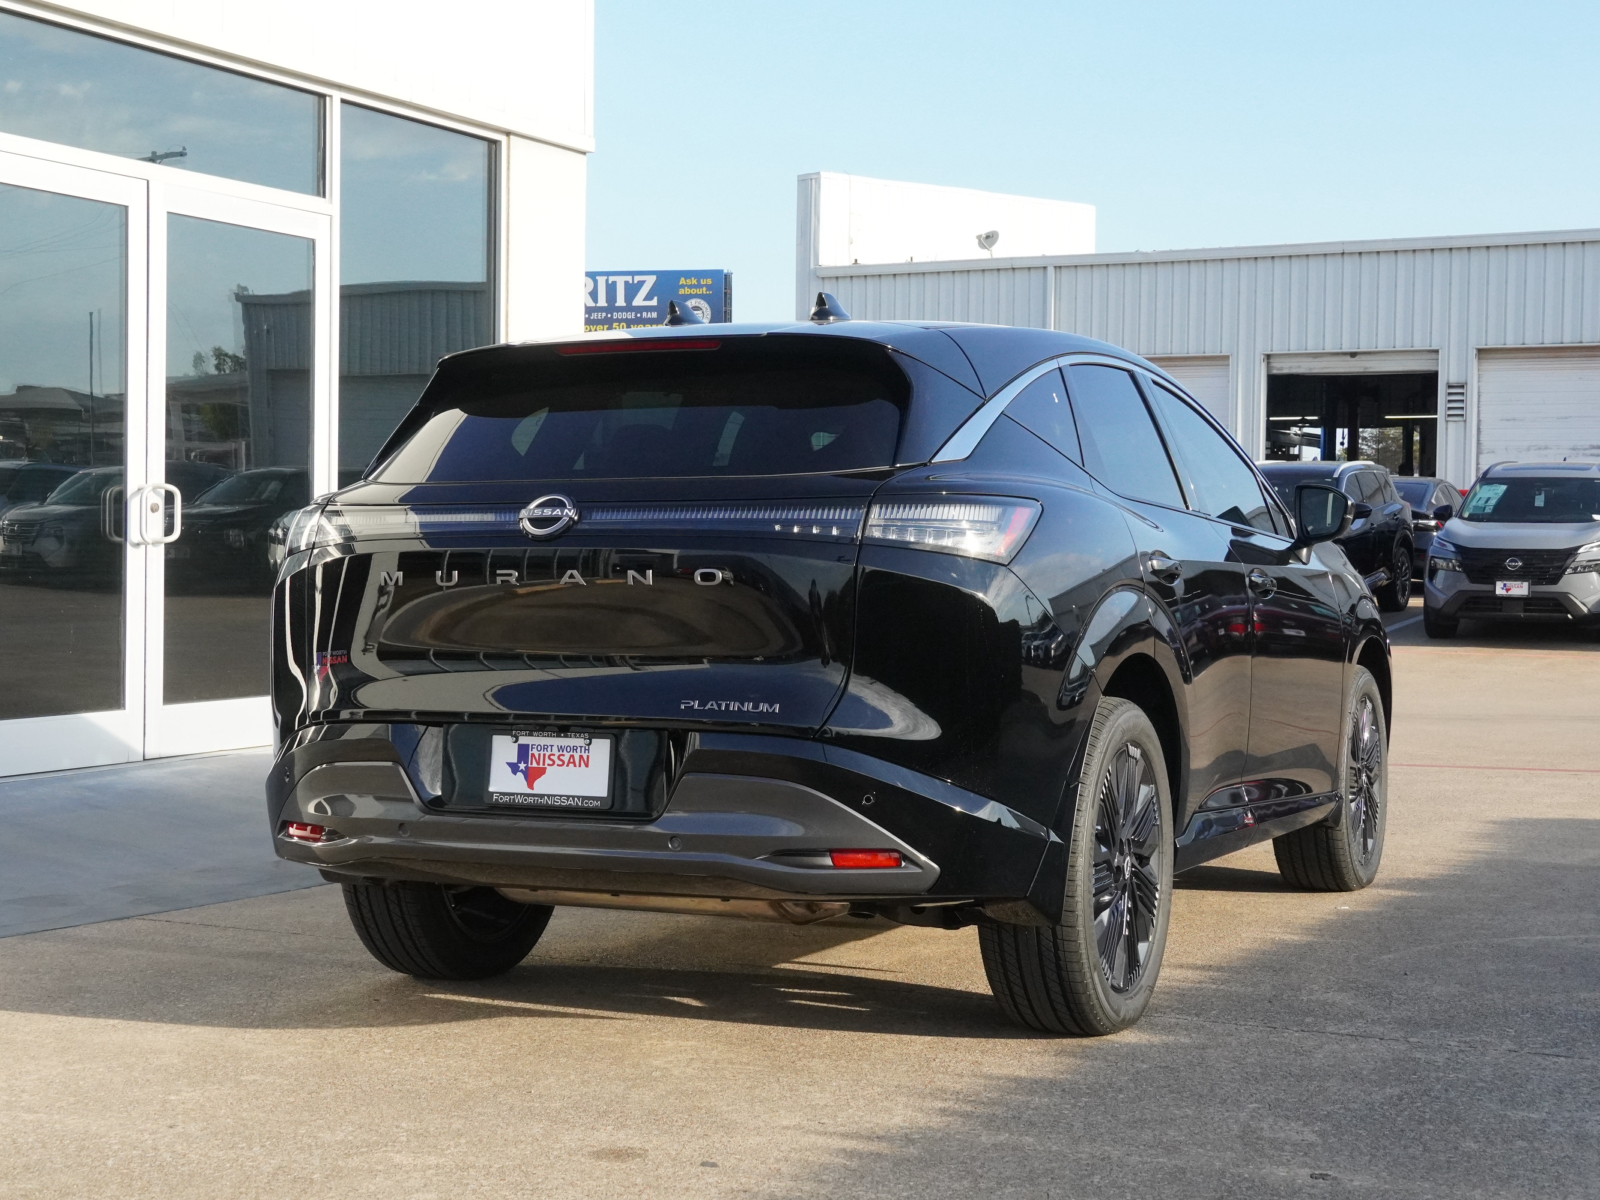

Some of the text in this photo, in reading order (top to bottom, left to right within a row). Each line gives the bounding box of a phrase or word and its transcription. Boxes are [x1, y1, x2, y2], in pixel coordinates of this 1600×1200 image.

[679, 277, 712, 285] Ask us
[590, 312, 606, 320] JEEP
[642, 311, 657, 319] RAM
[584, 324, 609, 332] over
[612, 322, 627, 330] 50
[379, 568, 723, 586] MURANO
[680, 700, 780, 713] PLATINUM
[530, 743, 590, 754] FORT WORTH
[529, 753, 591, 768] NISSAN
